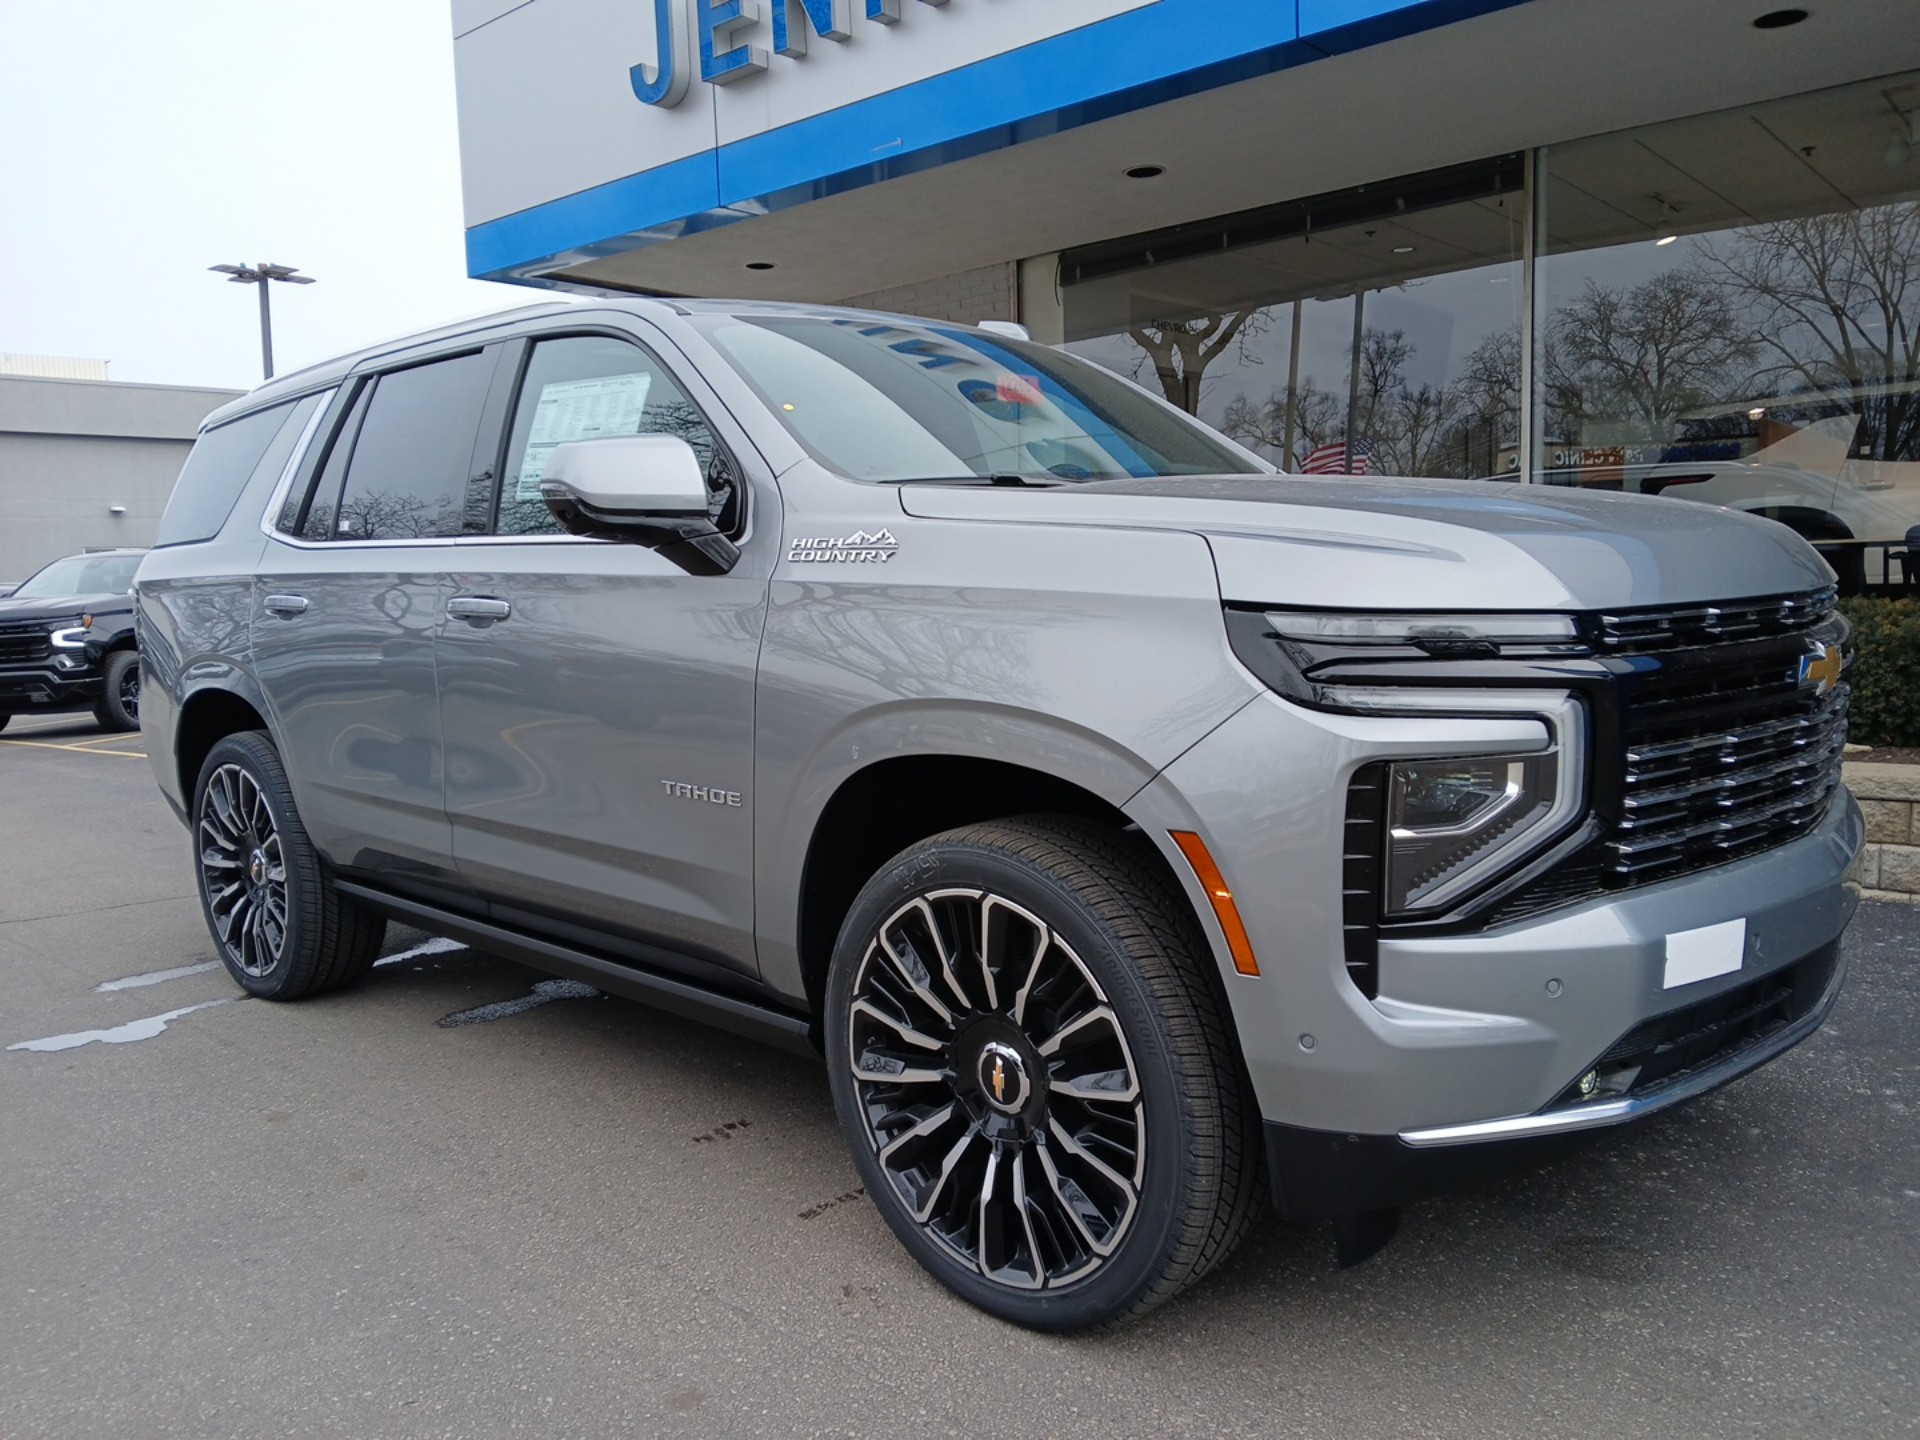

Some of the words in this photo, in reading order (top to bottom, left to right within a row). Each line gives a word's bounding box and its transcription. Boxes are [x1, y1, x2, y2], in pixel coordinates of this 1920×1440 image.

[791, 537, 845, 550] HIGH
[787, 549, 897, 563] COUNTRY
[660, 779, 742, 808] TAHOE
